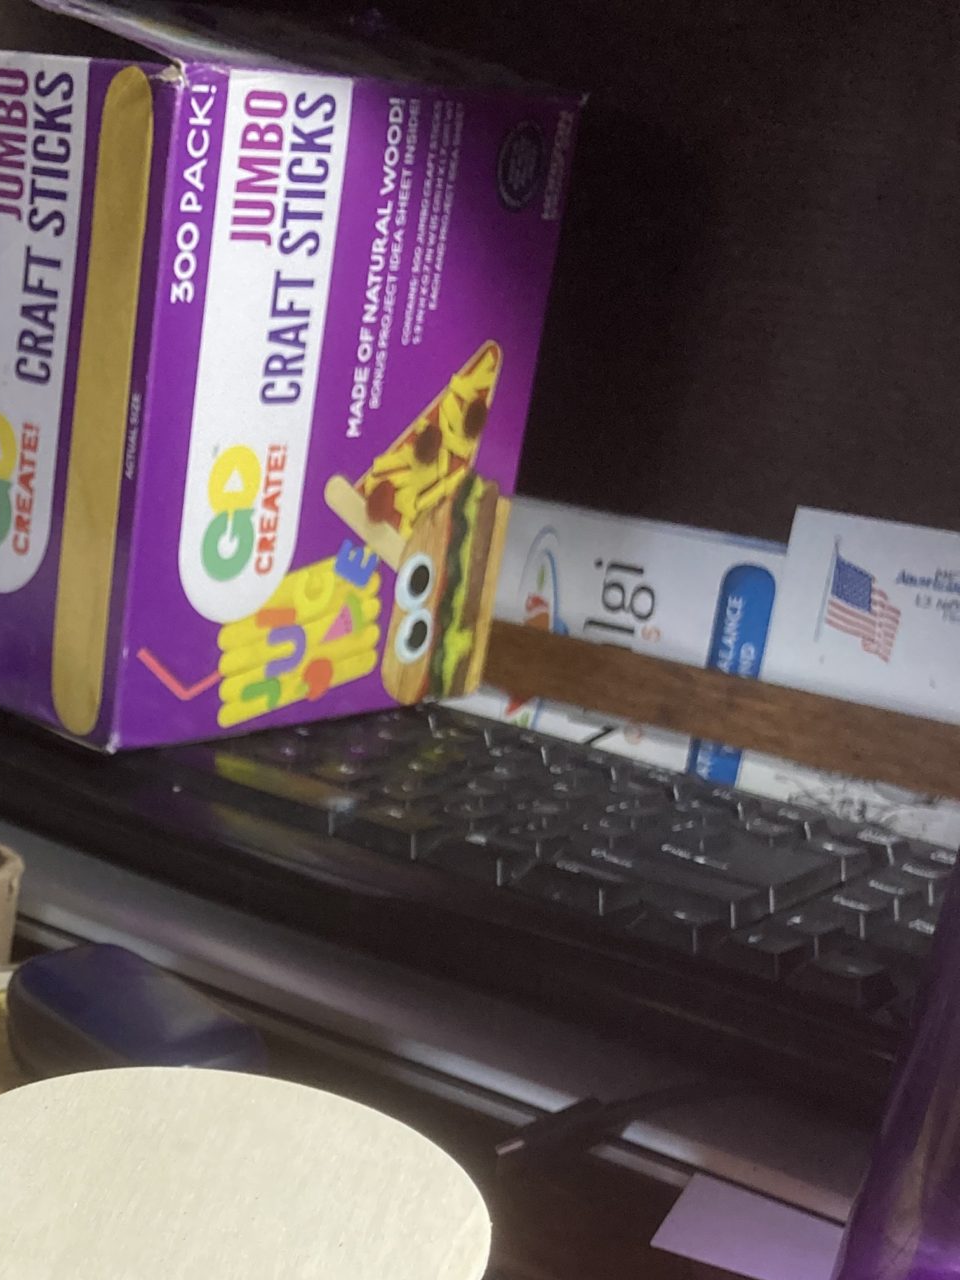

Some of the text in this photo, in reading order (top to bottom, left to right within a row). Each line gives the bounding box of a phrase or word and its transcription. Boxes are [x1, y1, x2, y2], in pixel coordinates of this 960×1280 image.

[15, 70, 74, 386] CRAFT STICKS
[170, 84, 217, 304] 300 PACK!
[229, 90, 288, 246] JUMBO
[259, 92, 337, 405] CRAFT STICKS
[346, 98, 406, 438] MADE OF NATURAL WOOD!
[369, 98, 420, 409] BONUS PROJECT IDEA SHEET INSIDE!
[12, 421, 40, 556] CREATE!
[254, 443, 287, 575] CREATE!
[715, 594, 746, 675] ALANCE
